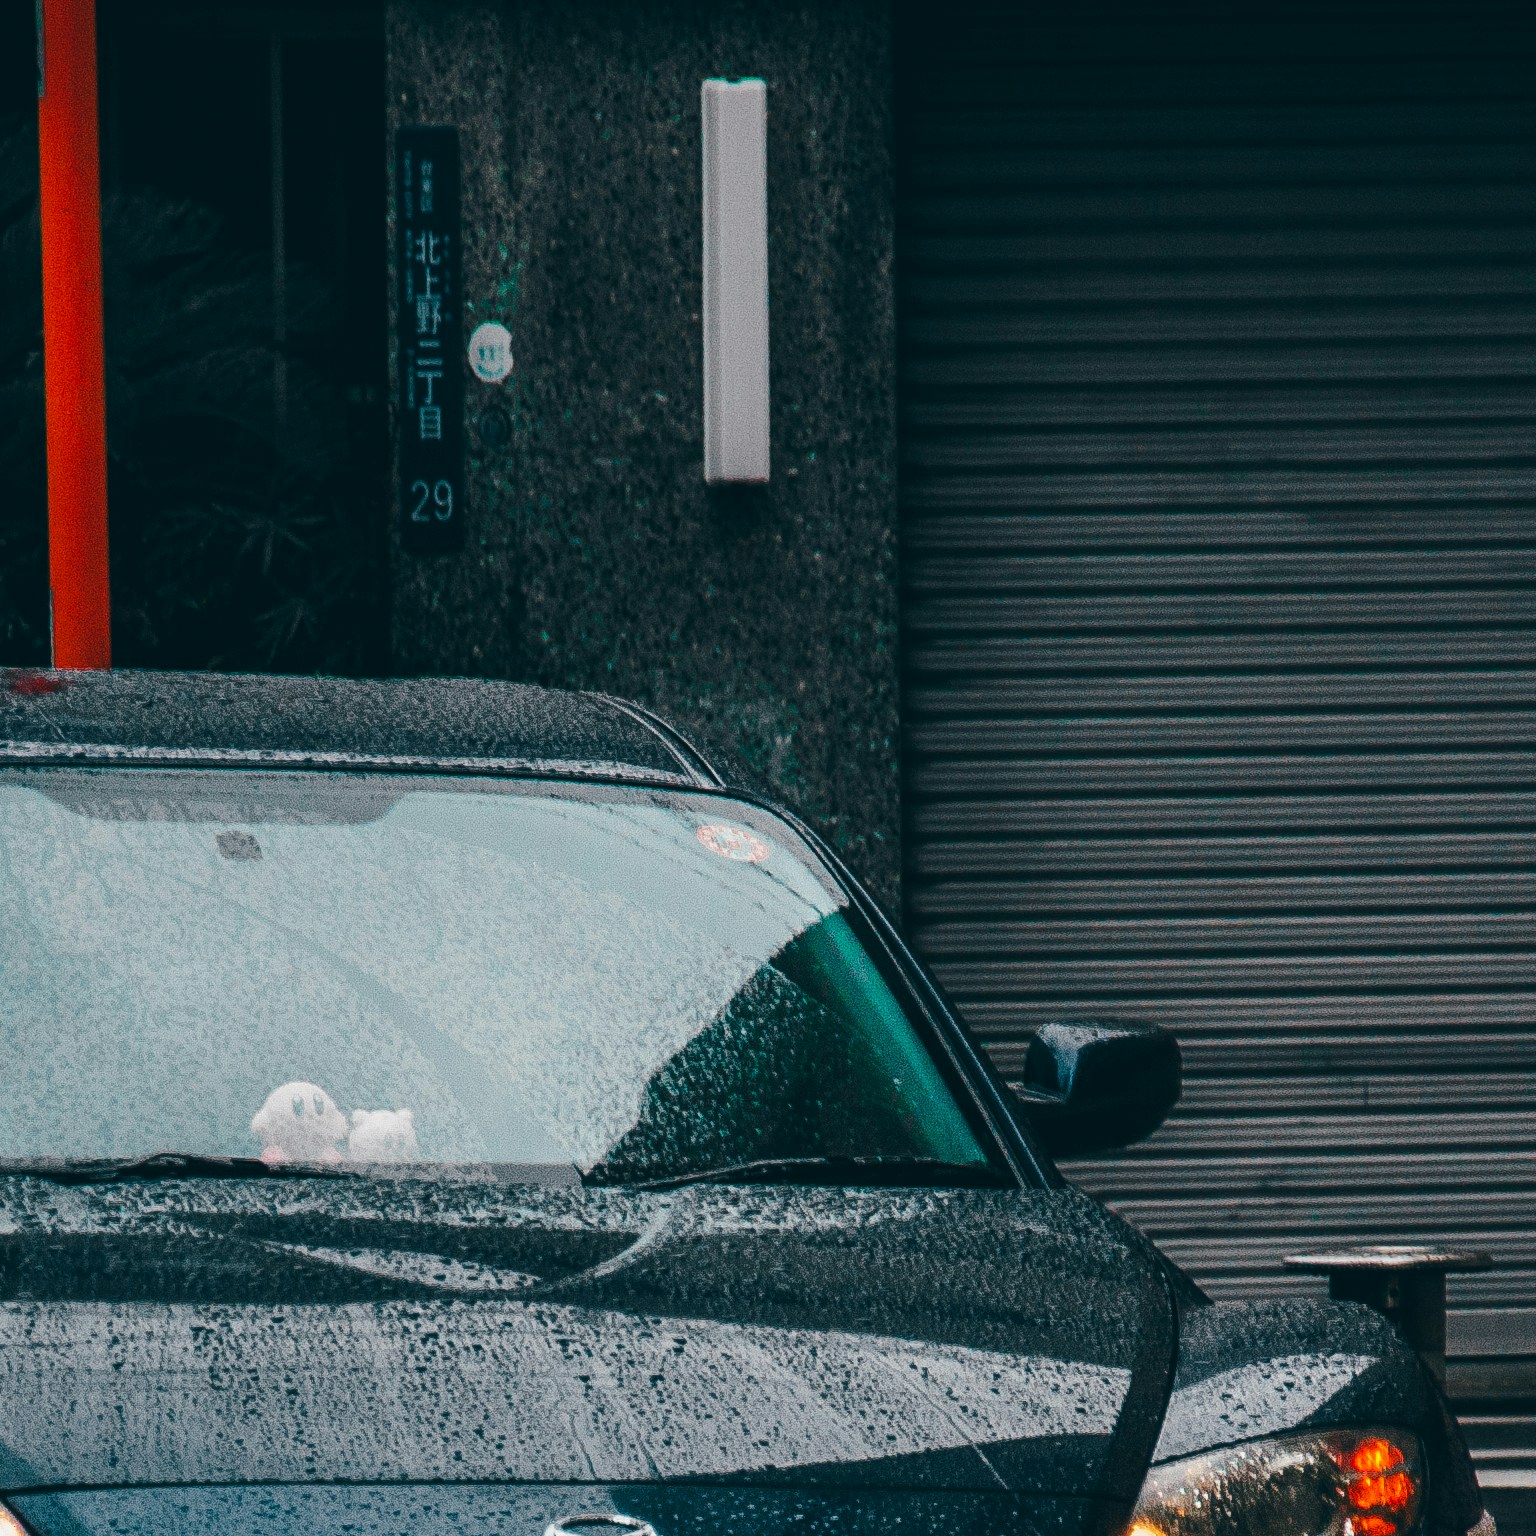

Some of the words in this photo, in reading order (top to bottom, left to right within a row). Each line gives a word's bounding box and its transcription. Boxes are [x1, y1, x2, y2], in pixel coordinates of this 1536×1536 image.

[415, 230, 444, 440] 北上野二丁目
[412, 479, 453, 522] 29
